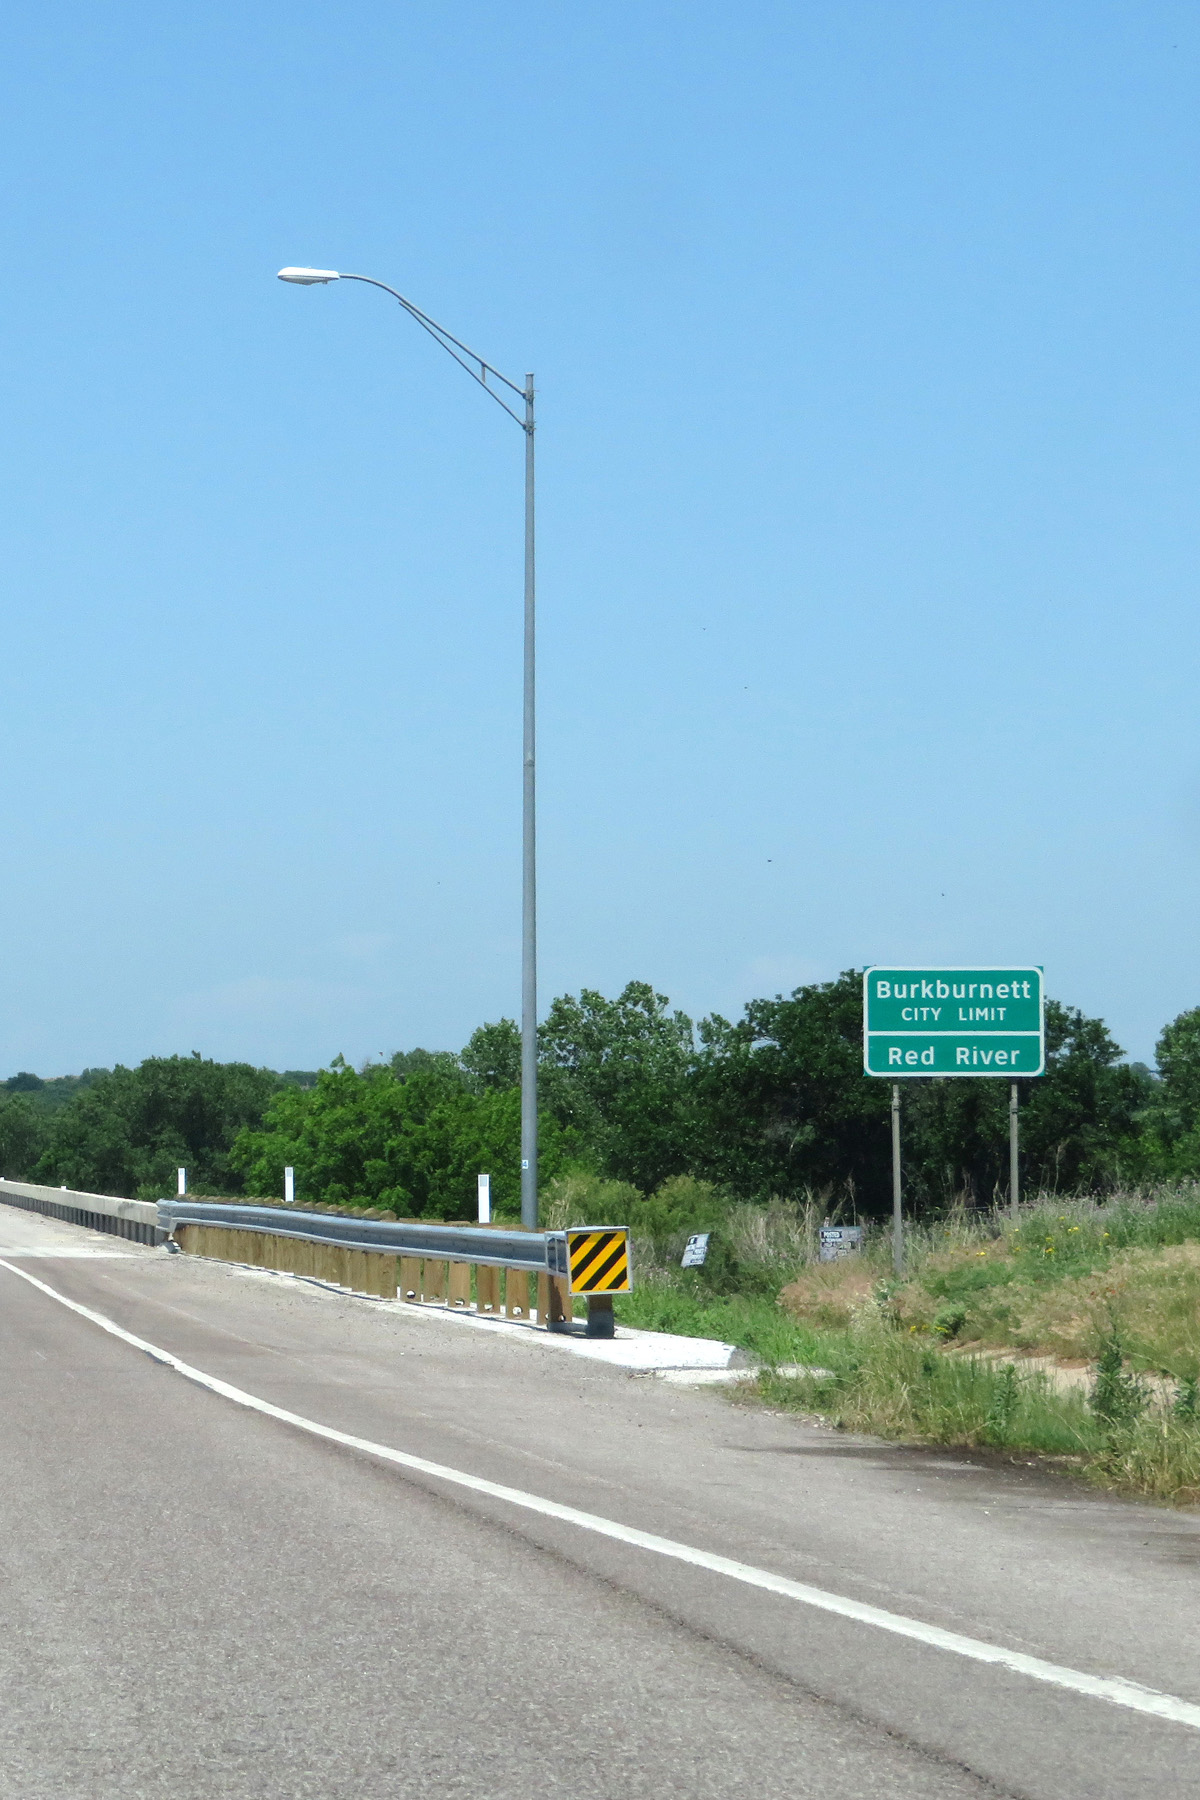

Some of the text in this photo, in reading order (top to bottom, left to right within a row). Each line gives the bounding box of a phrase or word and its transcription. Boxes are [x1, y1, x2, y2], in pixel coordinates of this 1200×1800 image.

[876, 979, 1031, 999] Burkburnett
[901, 1007, 1007, 1021] CITY LIMIT
[888, 1046, 1020, 1065] Red River
